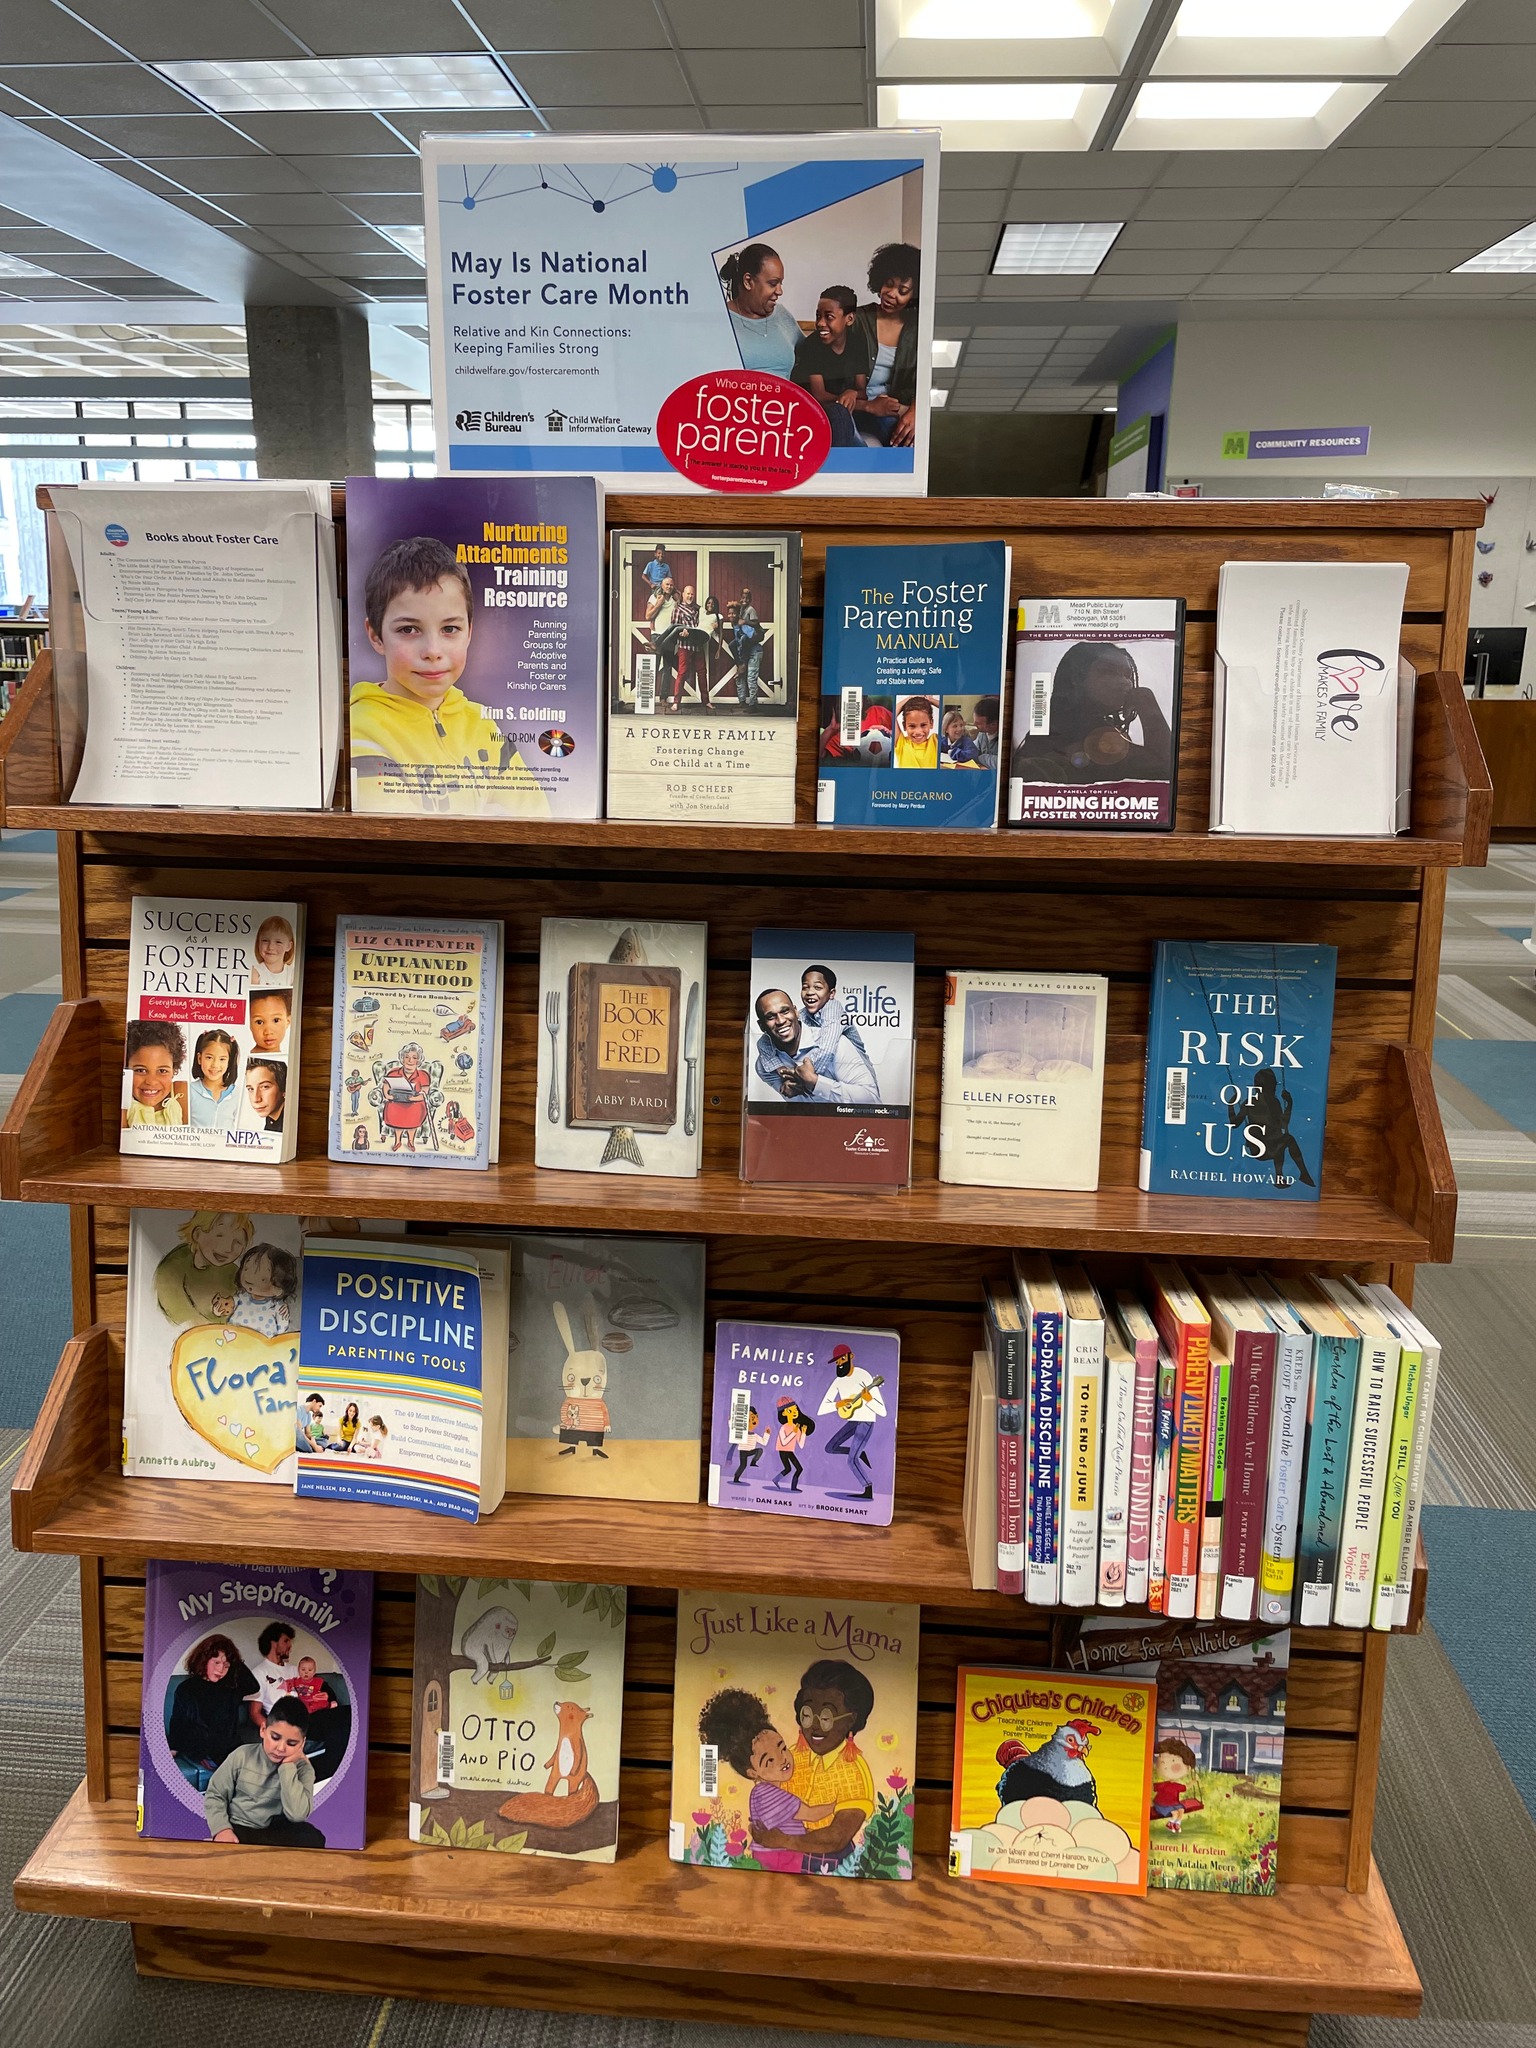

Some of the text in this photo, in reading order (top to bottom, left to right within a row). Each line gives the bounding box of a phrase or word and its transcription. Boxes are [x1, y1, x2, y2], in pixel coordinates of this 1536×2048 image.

[451, 250, 647, 279] May Is National
[453, 282, 688, 305] Foster Care Month
[453, 326, 631, 337] Relative and Kin Connections:
[454, 343, 598, 356] Keeping Families Strong
[455, 366, 599, 376] childwelfare.gov/fostercaremonth
[716, 378, 738, 390] Who
[740, 382, 757, 391] can
[760, 383, 772, 392] be
[696, 385, 799, 427] foster
[484, 411, 534, 422] Children's
[569, 416, 620, 424] Child Welfare
[485, 423, 521, 432] Bureau
[569, 425, 652, 435] Information Gateway
[676, 422, 813, 460] parent?
[1256, 438, 1360, 449] COMMUNITY RESOURCES
[145, 532, 279, 545] Books about Foster Care
[483, 521, 567, 544] Nurturing
[456, 544, 568, 565] Attachments
[494, 566, 568, 588] Training
[484, 587, 567, 608] Resource
[862, 580, 988, 605] The Foster
[533, 620, 567, 630] Running
[843, 604, 973, 634] Parenting
[528, 630, 567, 640] Parenting
[876, 633, 959, 650] MANUAL
[523, 640, 566, 651] Groups for
[517, 661, 566, 670] Parents and
[530, 651, 567, 661] Adoptive
[529, 672, 556, 680] Foster
[507, 681, 566, 692] Kinship Carers
[480, 705, 566, 722] Kim S. Golding
[1315, 667, 1329, 741] MAKES A FAMILY
[626, 728, 776, 741] A FOREVER FAMILY
[666, 784, 733, 792] ROB SCHEER
[872, 791, 952, 801] JOHN DEGARMO
[1024, 796, 1158, 810] FINDING HOME
[1022, 811, 1158, 820] A FOSTER YOUTH STORY
[143, 911, 252, 934] SUCCESS
[354, 935, 475, 950] LIZ CARPENTER
[145, 945, 250, 970] FOSTER
[362, 953, 468, 971] UNPLANNED
[142, 971, 248, 995] PARENT
[353, 970, 473, 987] PARENTHOOD
[619, 989, 649, 1004] THE
[846, 985, 896, 1014] a life
[1209, 993, 1277, 1015] THE
[603, 1003, 665, 1026] BOOK
[840, 1011, 900, 1027] around
[622, 1029, 643, 1042] OF
[605, 1041, 660, 1064] FRED
[1177, 1030, 1305, 1068] RISK
[595, 1095, 667, 1108] ABBY BARDI
[963, 1091, 1056, 1105] ELLEN FOSTER
[1220, 1084, 1263, 1106] OF
[226, 1131, 261, 1145] NFPA
[1202, 1122, 1266, 1158] US
[1170, 1169, 1296, 1186] RACHEL HOWARD
[337, 1272, 465, 1310] POSITIVE
[320, 1308, 474, 1350] DISCIPLINE
[328, 1345, 466, 1372] PARENTING TOOLS
[731, 1343, 814, 1365] FAMILIES
[1007, 1340, 1015, 1360] kathy
[739, 1370, 804, 1387] BELONG
[1038, 1320, 1054, 1489] NO-DRAMA DISCIPLINE
[1242, 1343, 1262, 1495] All the Children Are Home
[1176, 1337, 1209, 1524] PARENT LIKE IT MATTERS
[1356, 1351, 1386, 1530] HOW TO RAISE SUCCESSFUL PEOPLE
[1077, 1384, 1089, 1502] TO the END of JUNE
[139, 1455, 215, 1469] Annette Aubrey
[1129, 1373, 1155, 1544] THREE PENNIES
[1272, 1396, 1296, 1562] Beyond the Foster Care System
[178, 1580, 341, 1634] My Stepfamily
[690, 1606, 902, 1662] Just Like a Mama
[1065, 1630, 1240, 1671] Home for A While
[971, 1690, 1142, 1734] Chiquita's Children
[462, 1714, 536, 1742] OTTO
[460, 1754, 488, 1766] AND
